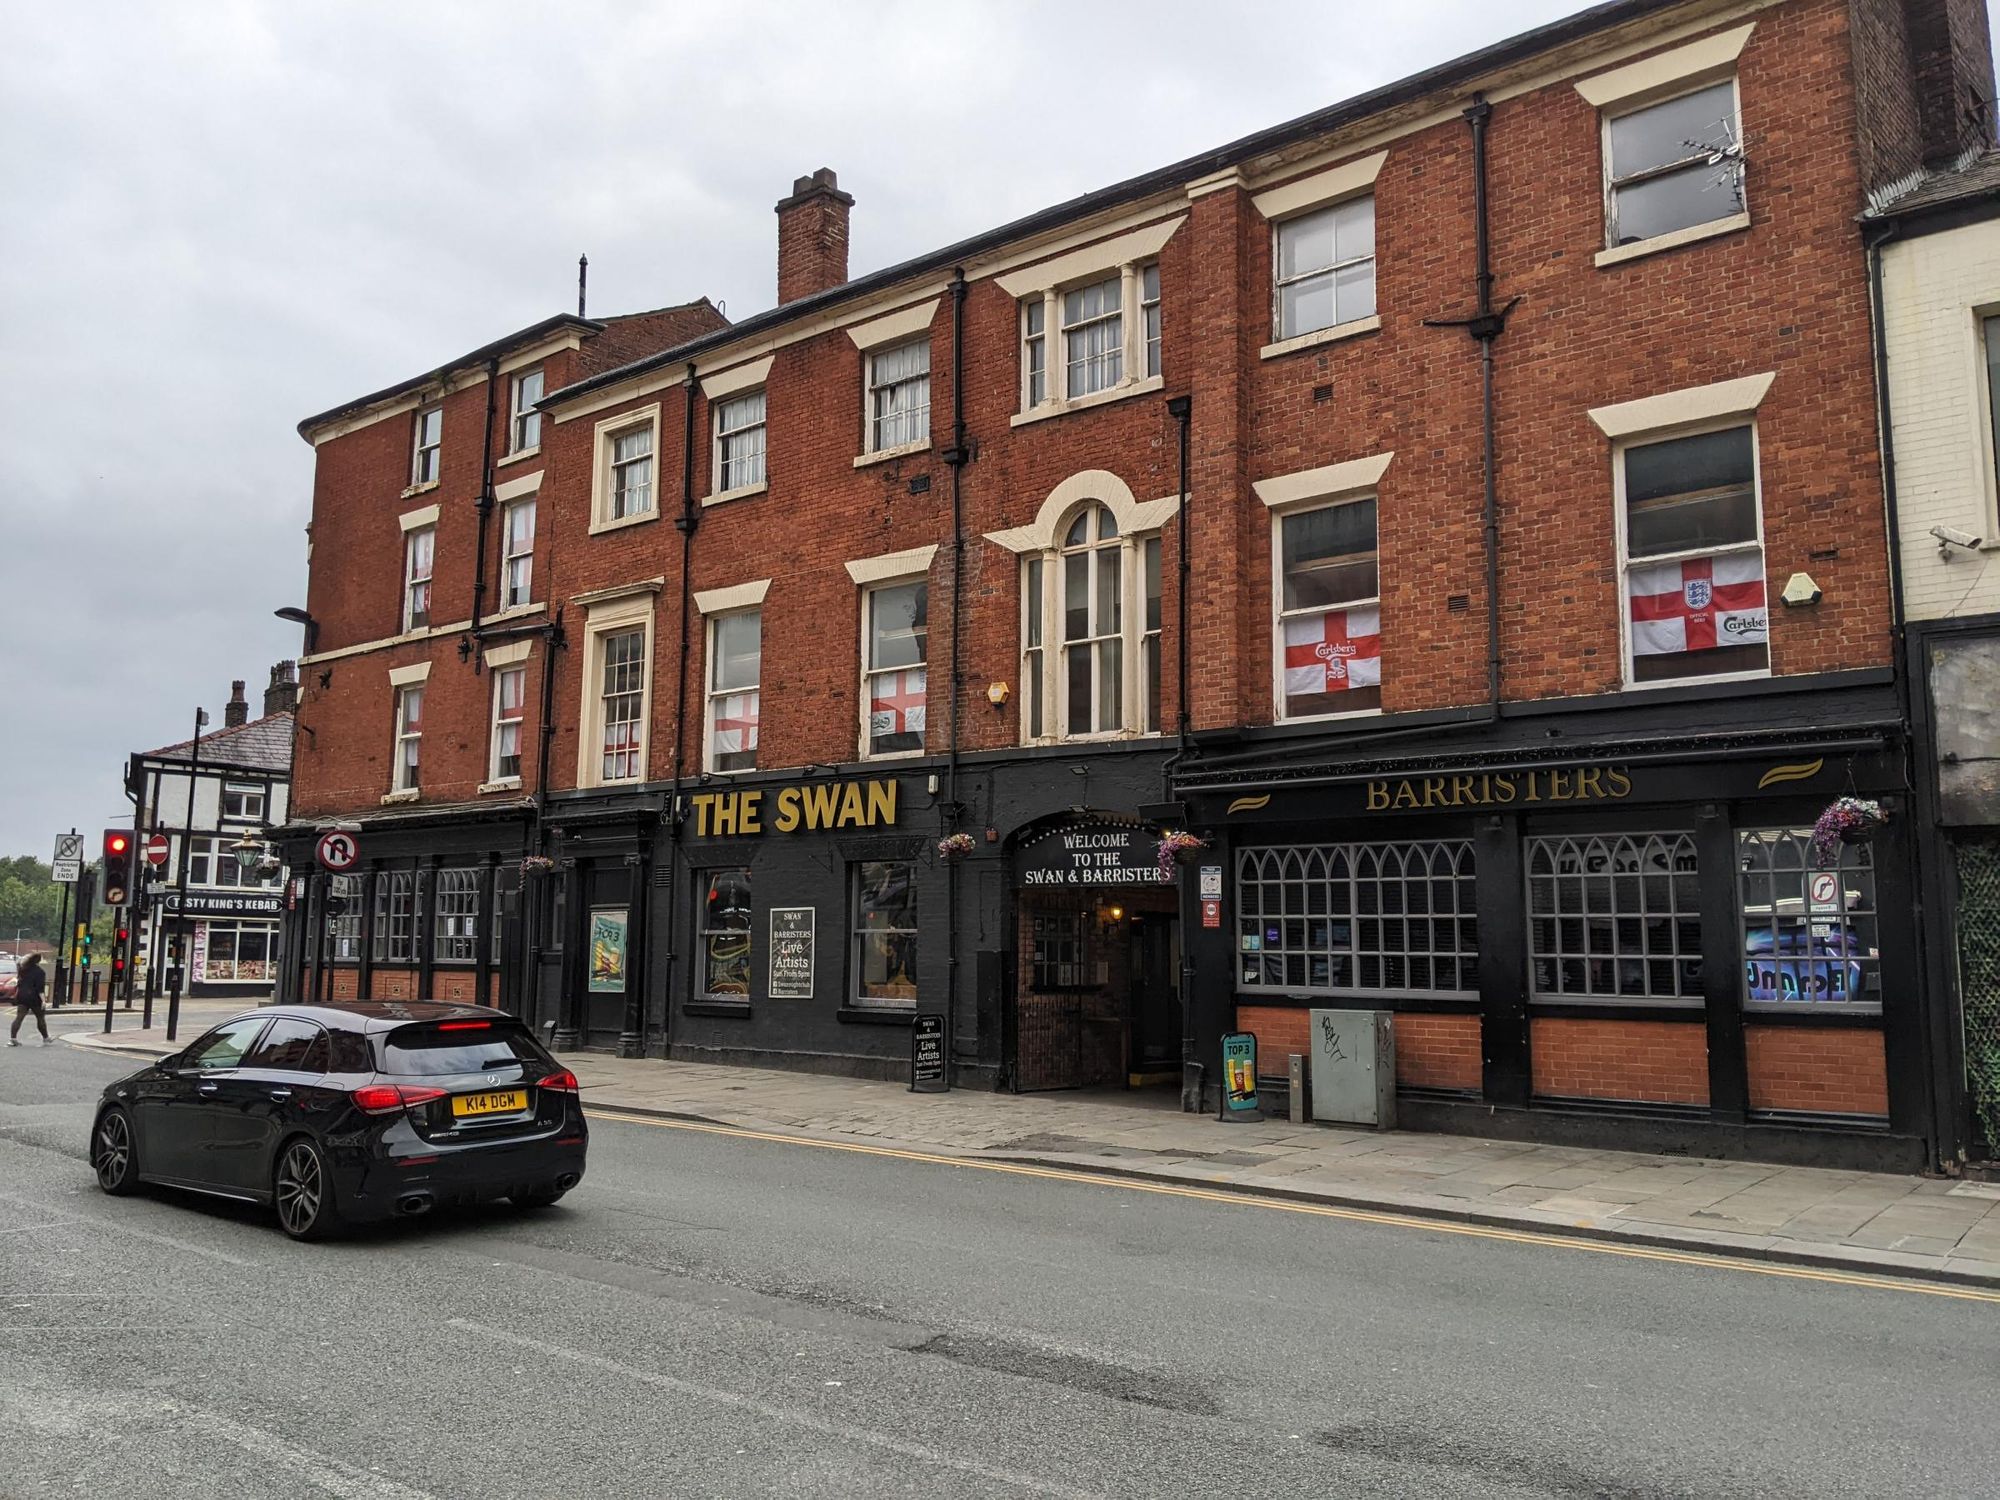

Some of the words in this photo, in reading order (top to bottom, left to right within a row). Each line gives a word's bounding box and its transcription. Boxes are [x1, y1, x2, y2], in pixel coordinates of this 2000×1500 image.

[1724, 617, 1767, 634] Carlsbe
[1315, 642, 1356, 660] Carlsberg
[1366, 766, 1631, 810] BARRISTERS
[692, 790, 762, 836] THE
[775, 779, 897, 832] SWAN
[1064, 833, 1129, 849] WELCOME
[1072, 853, 1091, 867] TO
[1094, 852, 1121, 866] THE
[1025, 868, 1064, 884] SWAN
[1068, 871, 1078, 883] &
[1083, 867, 1170, 883] BARRISTERS
[173, 898, 206, 908] TSTY
[208, 899, 244, 910] KING'S
[245, 900, 278, 910] KEBAB
[784, 912, 802, 920] SWAN
[614, 932, 620, 941] 3
[774, 930, 811, 938] BARRISTERS
[781, 941, 803, 954] Live
[776, 956, 808, 968] Artists
[921, 1041, 936, 1050] Live
[1227, 1045, 1243, 1055] TOP
[1244, 1045, 1250, 1055] 3
[917, 1051, 940, 1061] Artists
[466, 1097, 487, 1111] K14
[491, 1094, 516, 1108] DGM
